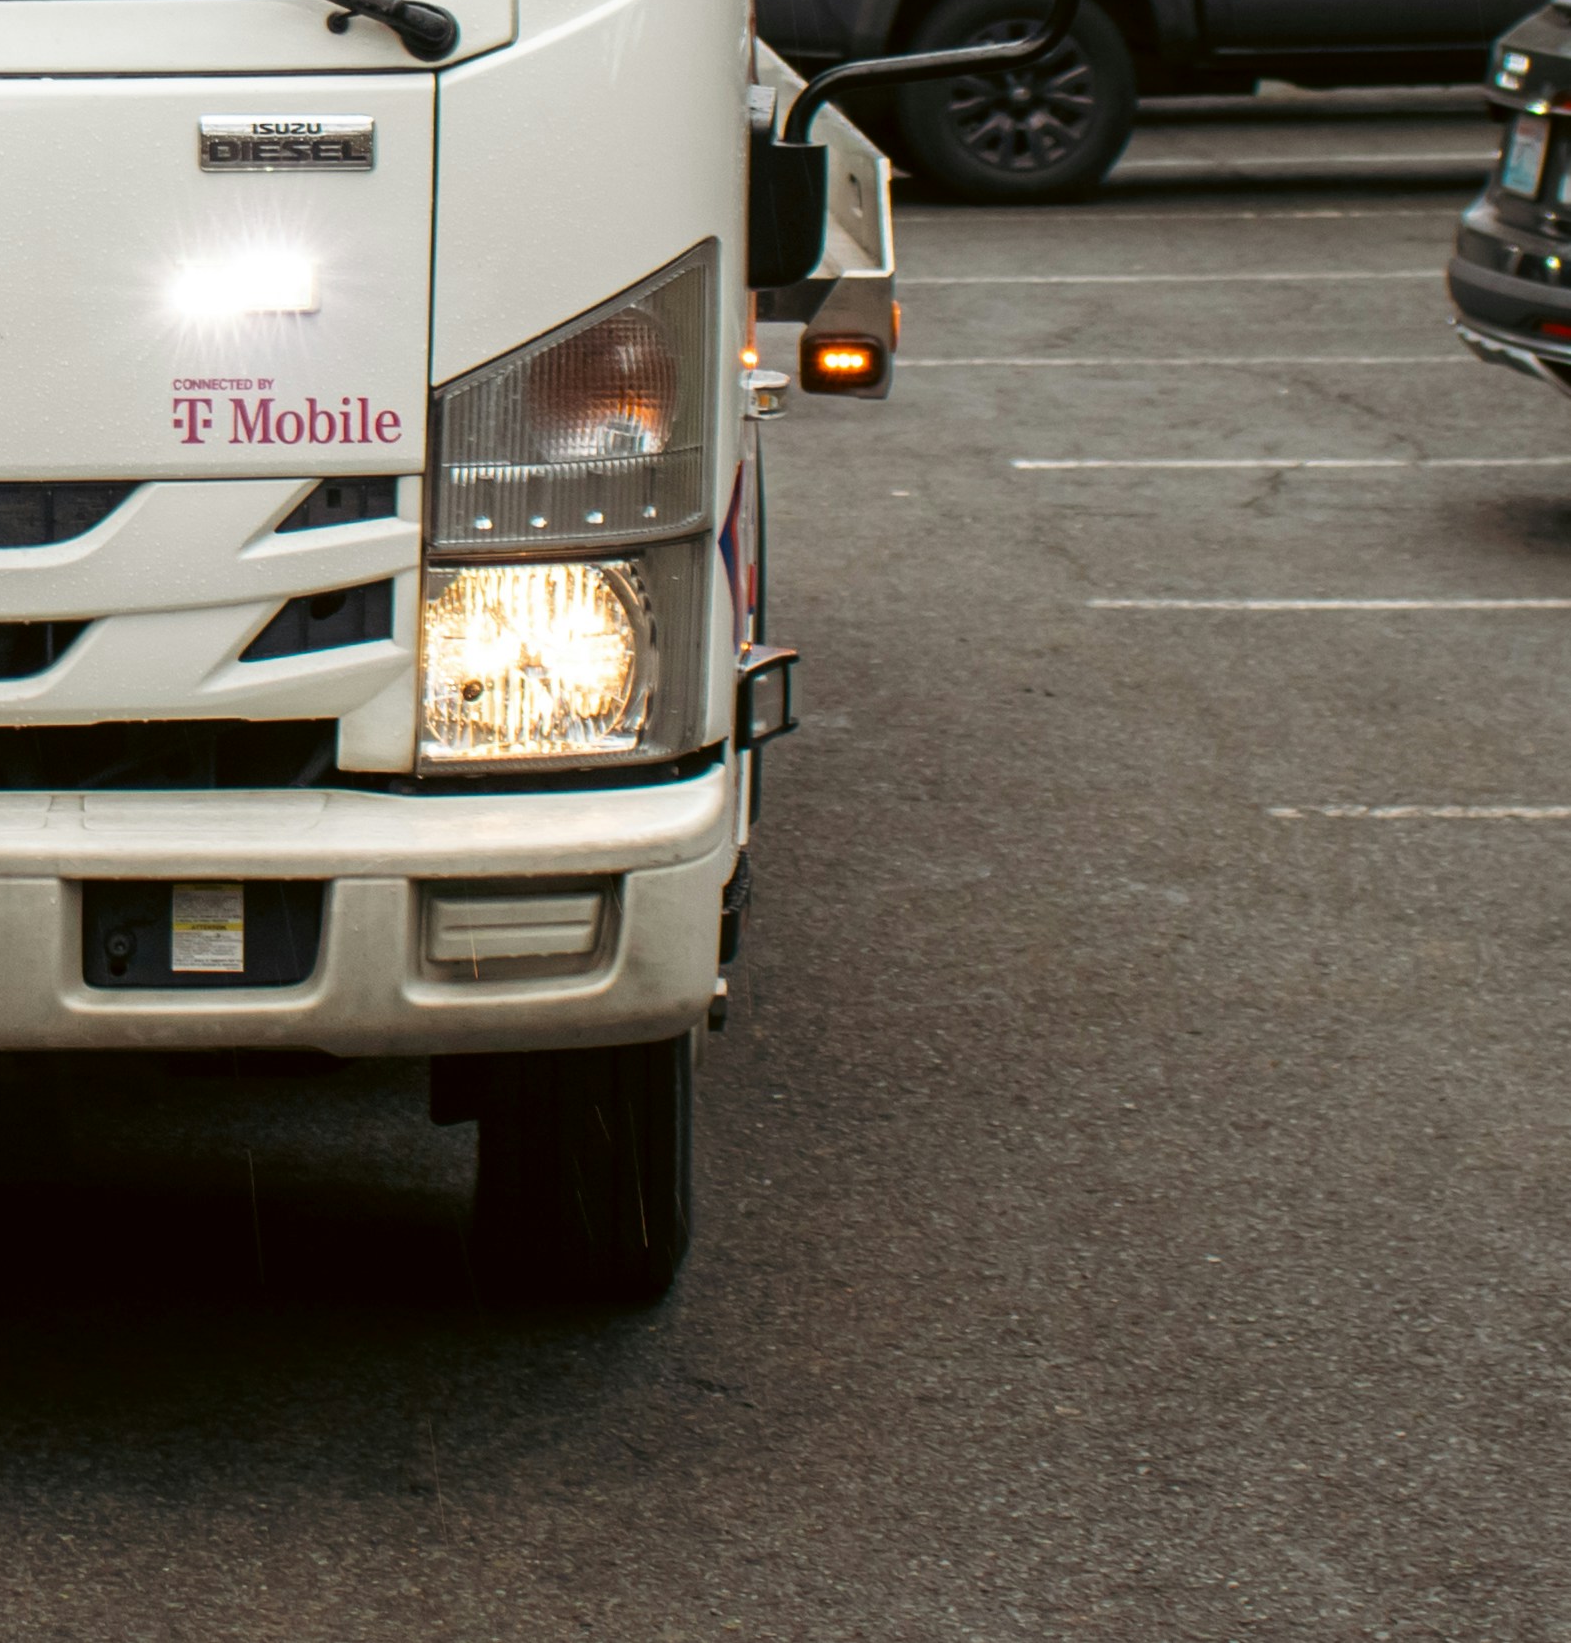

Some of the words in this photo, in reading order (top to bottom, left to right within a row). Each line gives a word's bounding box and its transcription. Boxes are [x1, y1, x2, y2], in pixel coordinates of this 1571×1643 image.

[252, 122, 323, 135] ISUZU
[208, 140, 368, 162] DIESEL
[172, 378, 253, 390] CONNECTED
[257, 378, 275, 390] BY
[228, 396, 402, 445] Mobile
